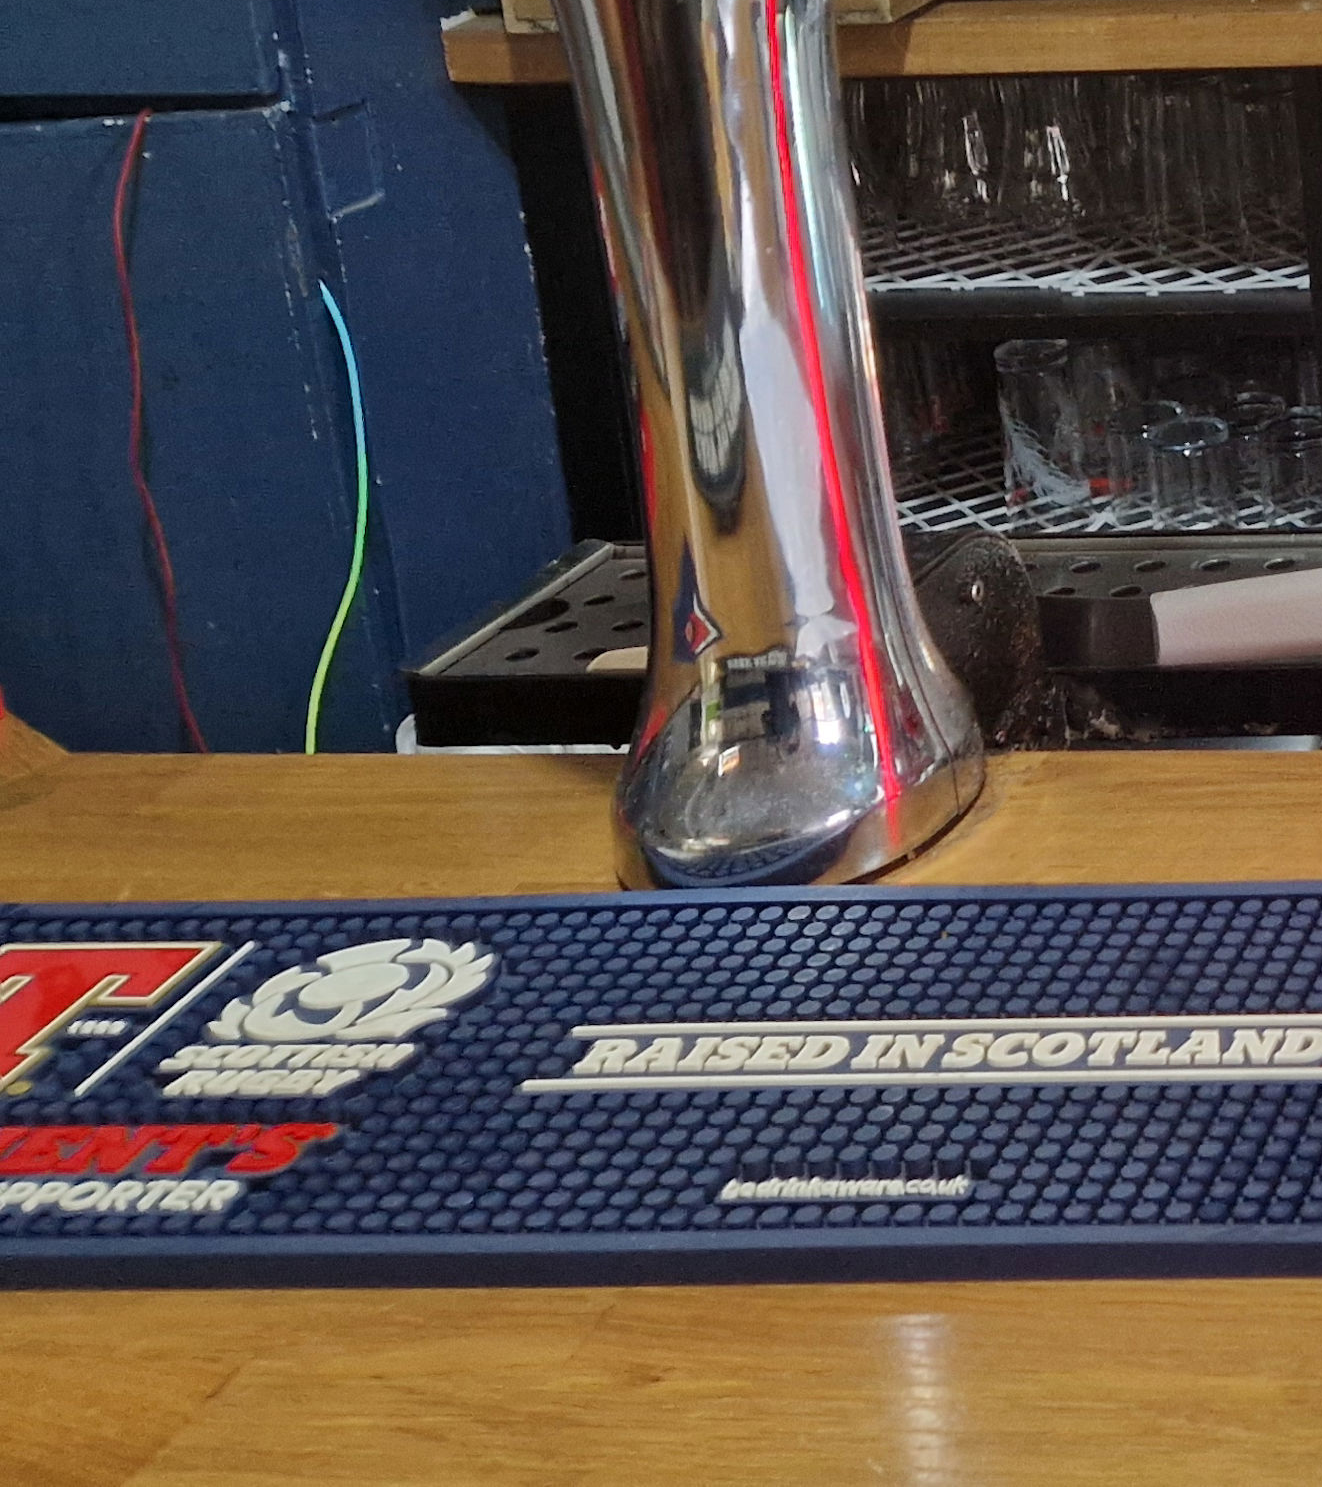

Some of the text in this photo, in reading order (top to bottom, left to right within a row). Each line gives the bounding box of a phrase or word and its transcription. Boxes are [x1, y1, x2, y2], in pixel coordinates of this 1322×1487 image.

[157, 1042, 416, 1073] SCOTTISH
[572, 1034, 851, 1076] RAISED
[849, 1032, 944, 1071] IN
[160, 1069, 364, 1098] RUGBY
